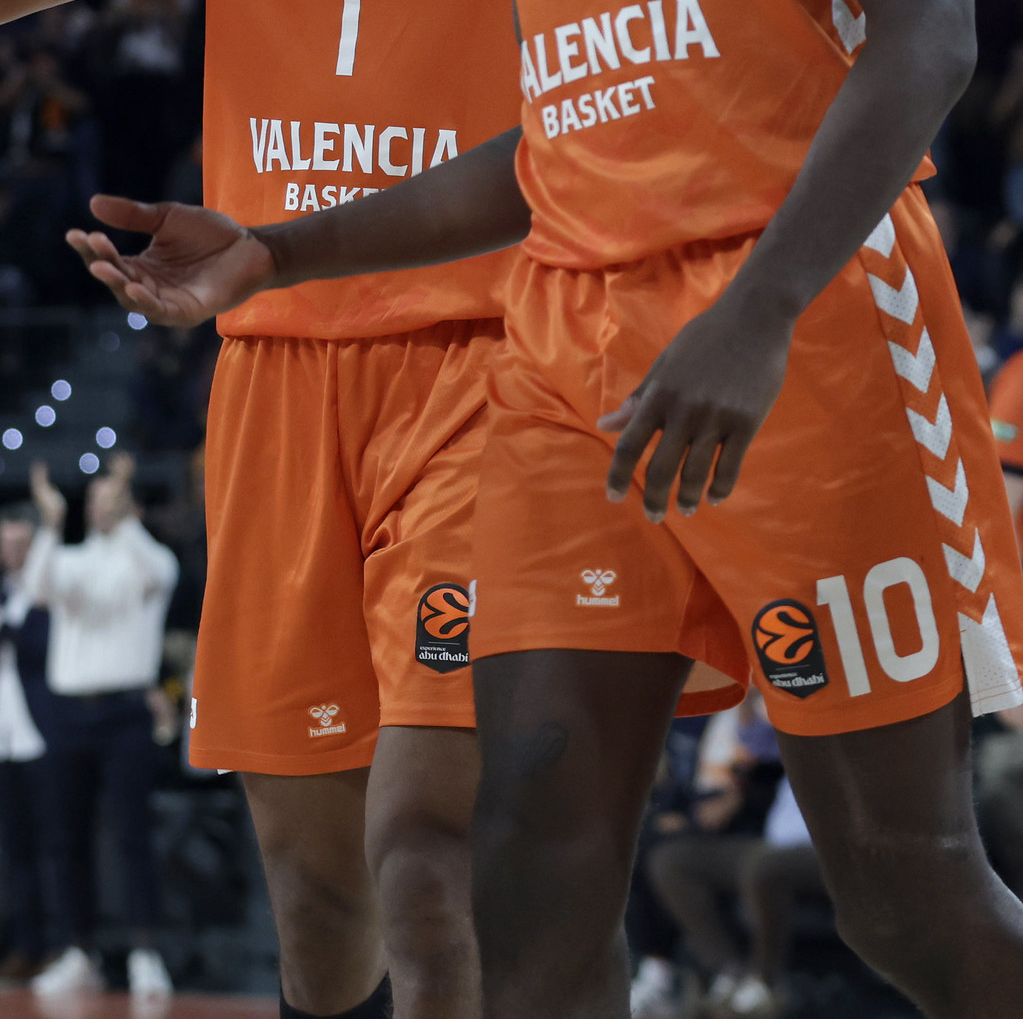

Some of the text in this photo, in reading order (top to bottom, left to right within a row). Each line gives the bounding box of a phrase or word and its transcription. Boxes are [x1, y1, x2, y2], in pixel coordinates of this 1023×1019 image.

[542, 76, 656, 140] BASKET
[249, 117, 459, 178] VALENCIA
[284, 183, 386, 212] BASK
[576, 594, 620, 606] hummel
[816, 556, 940, 698] 10
[418, 651, 469, 662] abu dhabi
[309, 723, 346, 737] hummel
